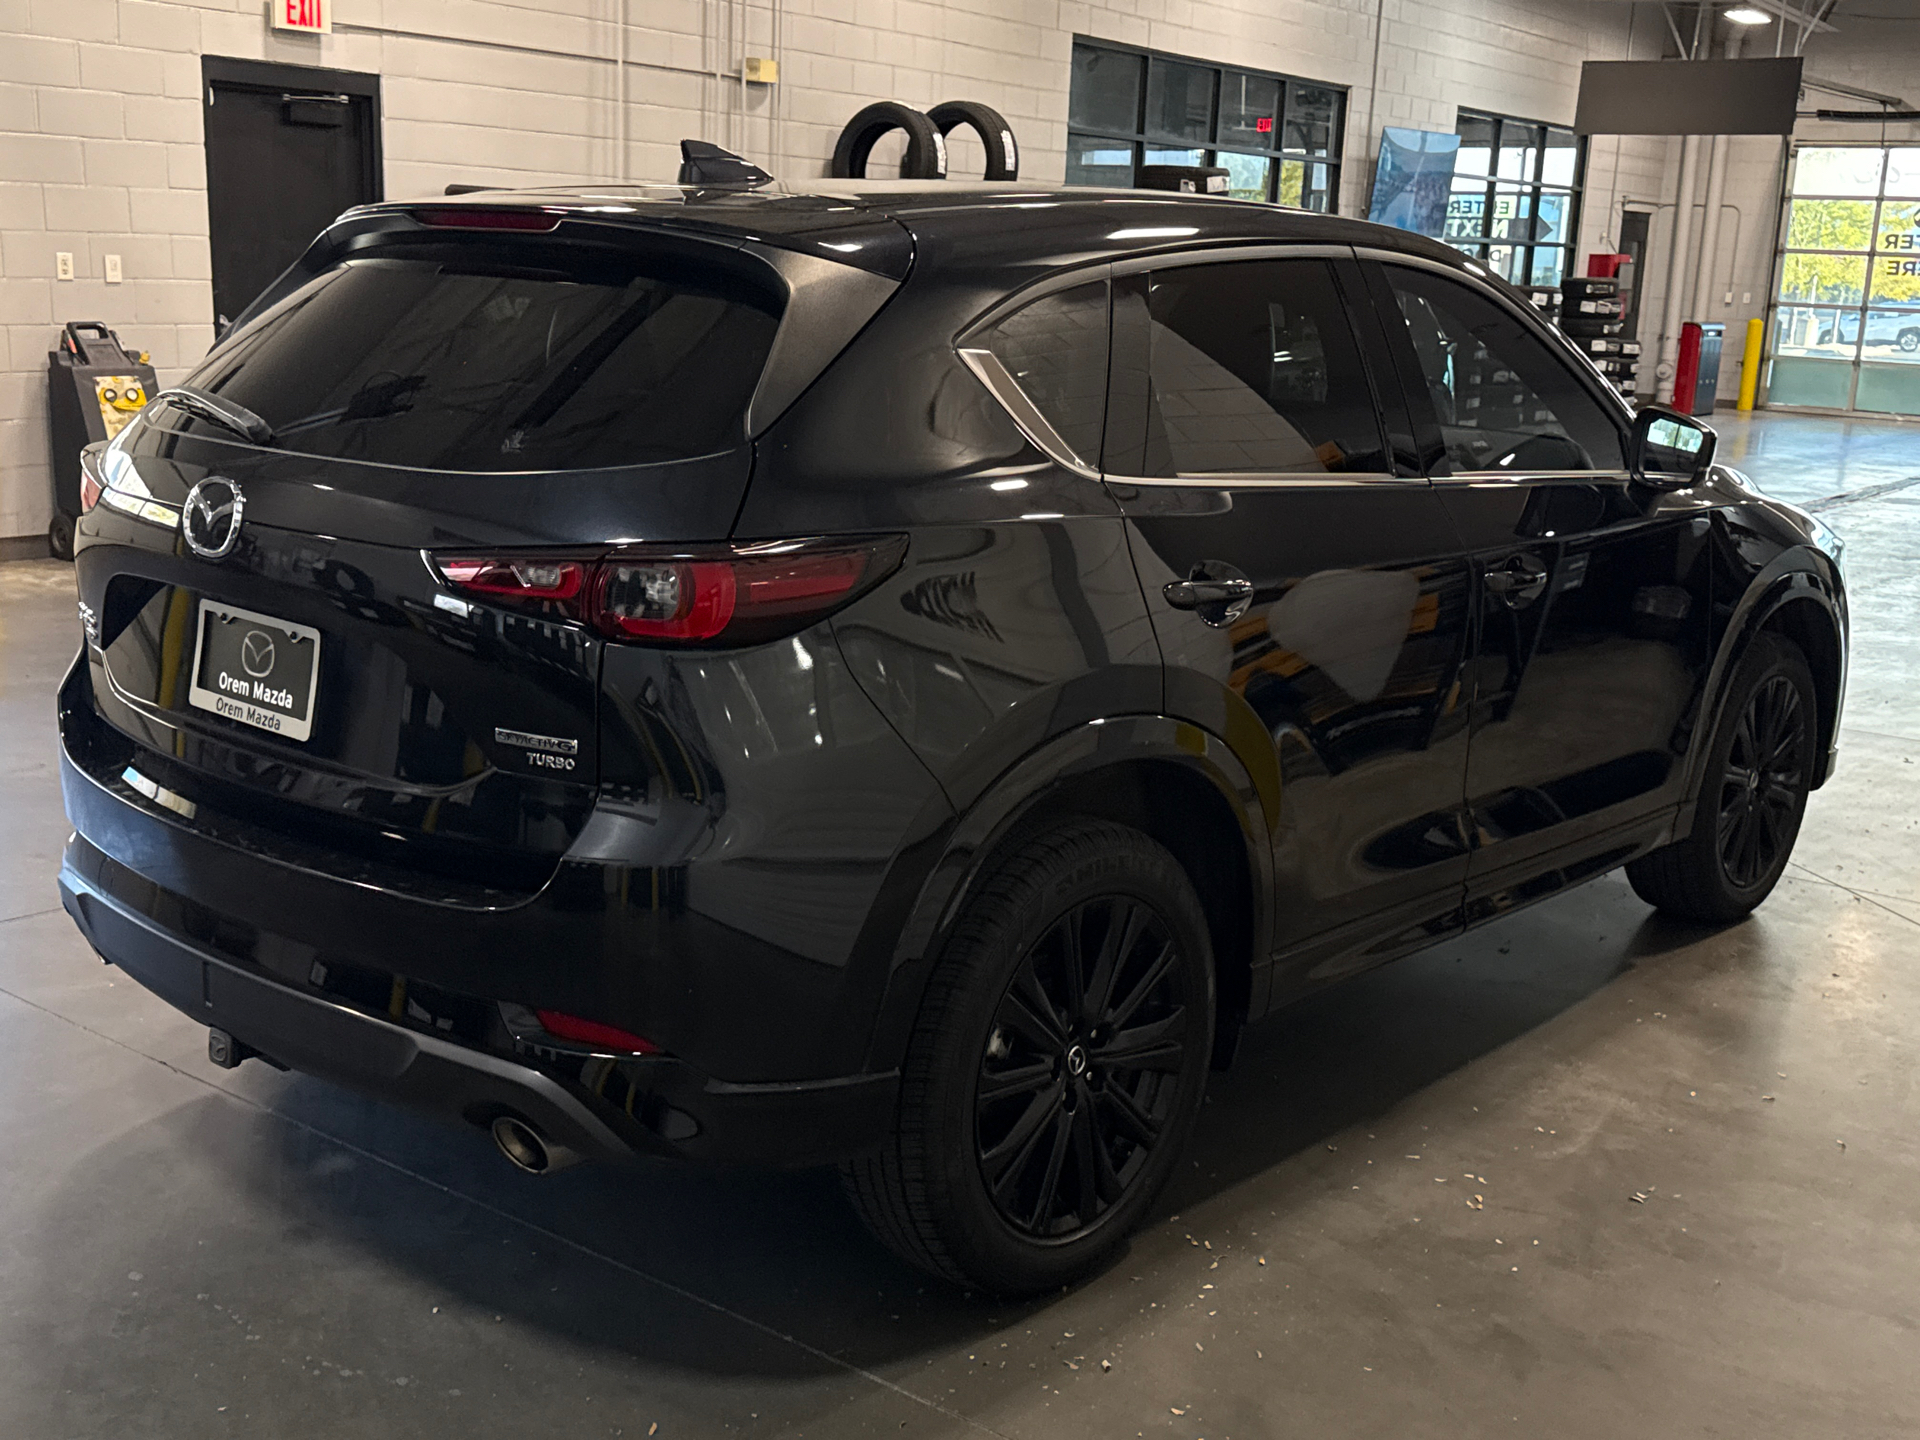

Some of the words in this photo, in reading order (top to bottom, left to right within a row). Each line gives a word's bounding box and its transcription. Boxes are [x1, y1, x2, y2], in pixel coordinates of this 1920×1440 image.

[286, 0, 322, 28] EXIT
[218, 671, 250, 697] Orem
[252, 681, 294, 709] Mazda
[216, 697, 244, 719] Orem
[246, 706, 281, 731] Mazda
[526, 752, 576, 770] TURBO
